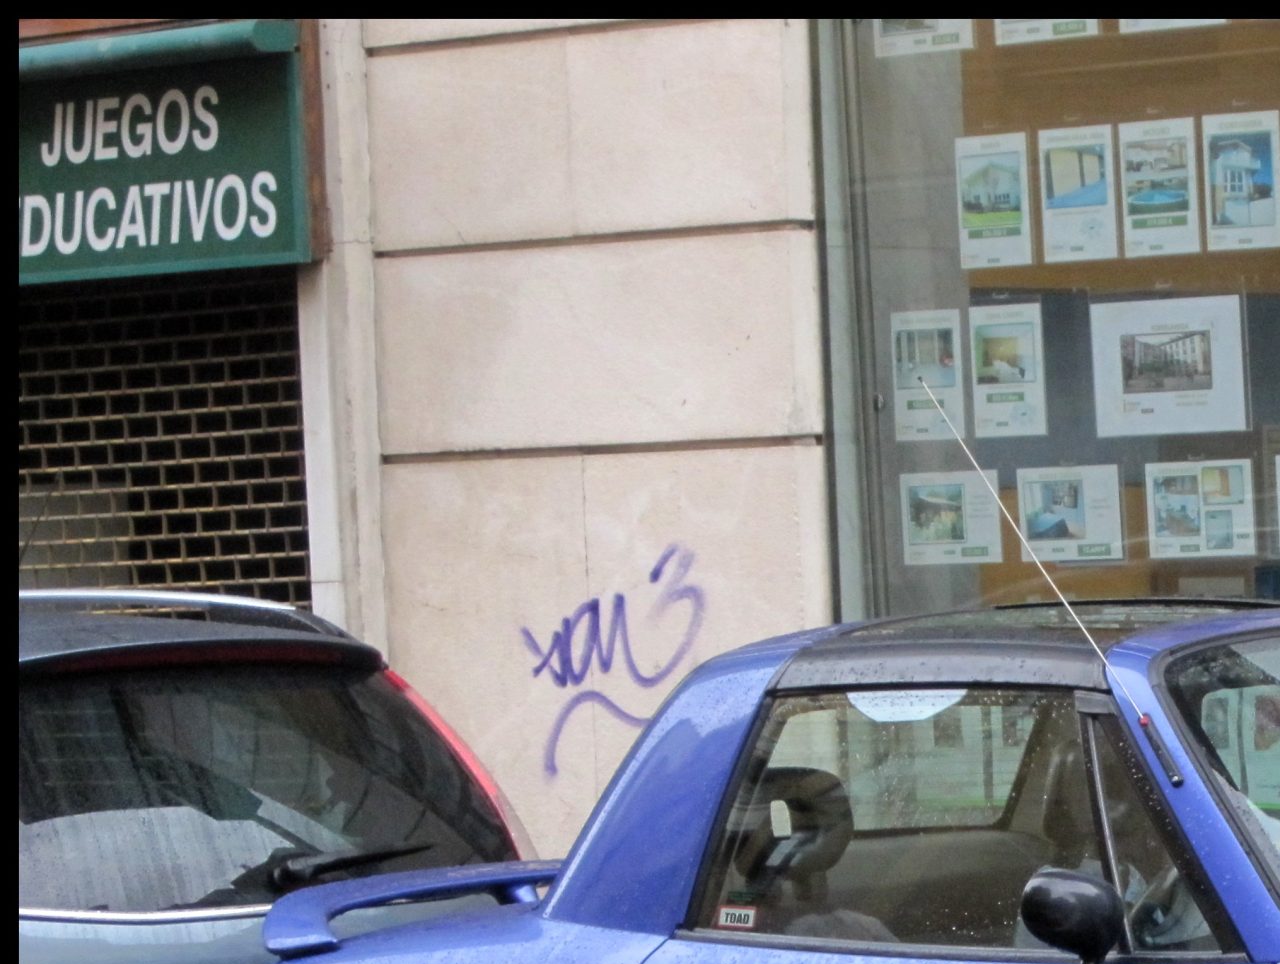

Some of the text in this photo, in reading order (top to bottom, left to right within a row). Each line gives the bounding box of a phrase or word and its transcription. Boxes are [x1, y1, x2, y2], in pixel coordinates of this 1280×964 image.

[41, 85, 219, 167] JUEGOS
[19, 170, 278, 257] DUCATIVOS
[725, 912, 749, 924] TOAD
